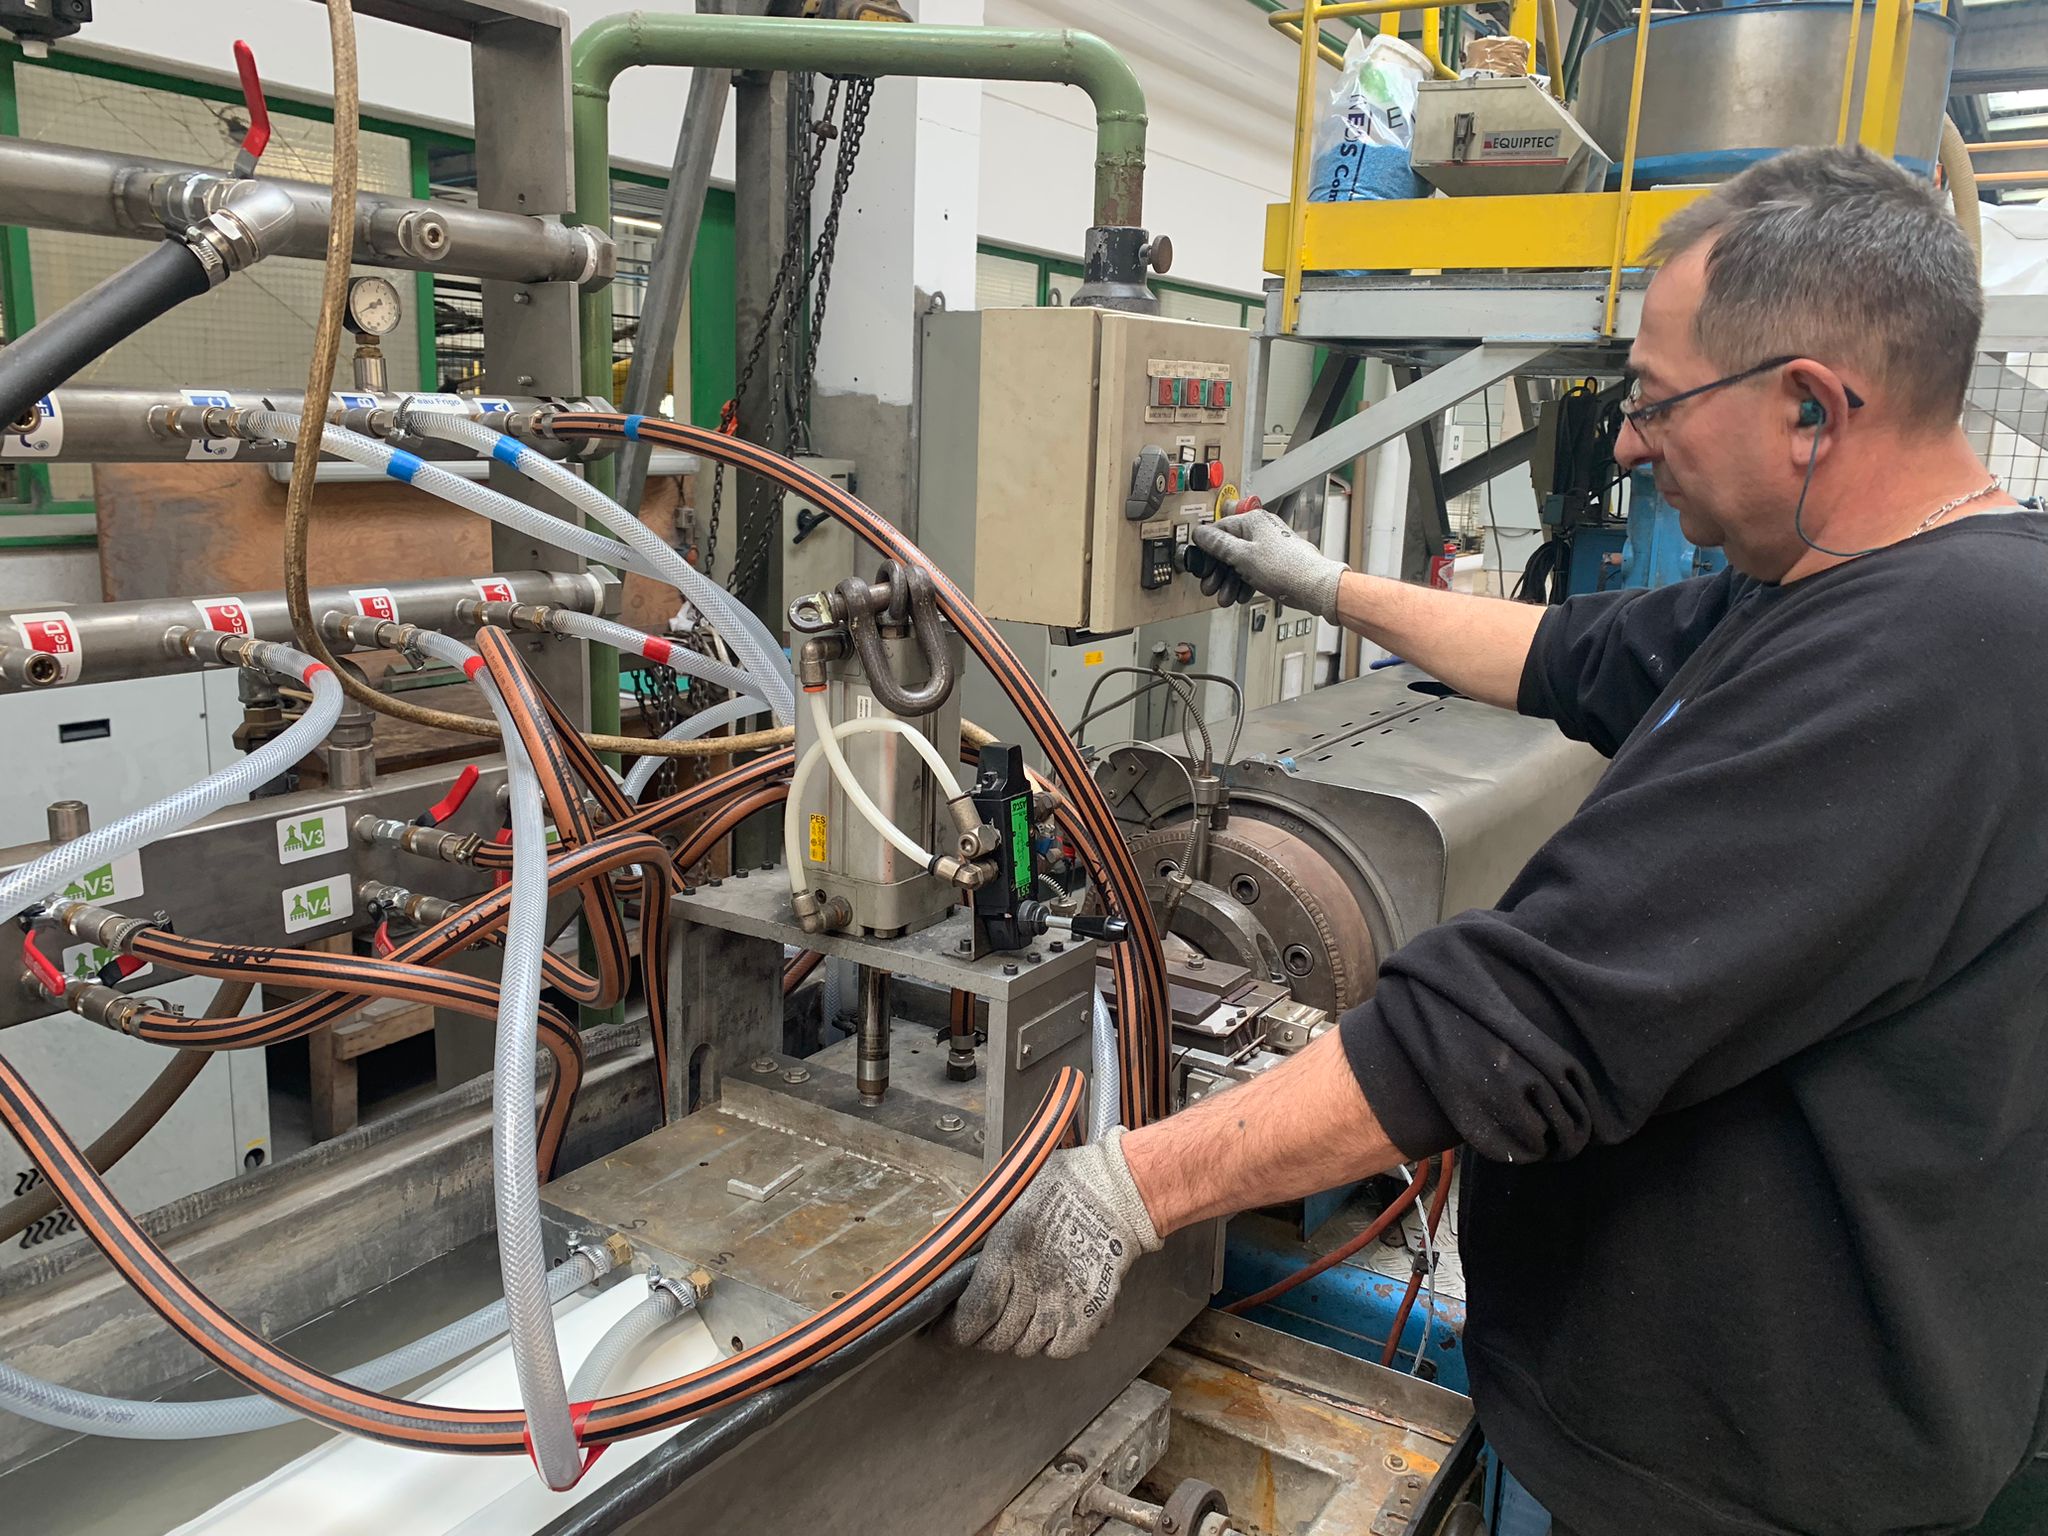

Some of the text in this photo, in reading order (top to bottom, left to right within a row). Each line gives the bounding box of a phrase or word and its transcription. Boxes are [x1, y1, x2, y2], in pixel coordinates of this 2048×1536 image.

[1493, 136, 1555, 149] EQUIPTEC
[810, 814, 826, 824] PES
[302, 827, 325, 847] V3
[84, 874, 113, 895] V5
[308, 899, 331, 918] V4
[1083, 1262, 1114, 1318] SINGER
